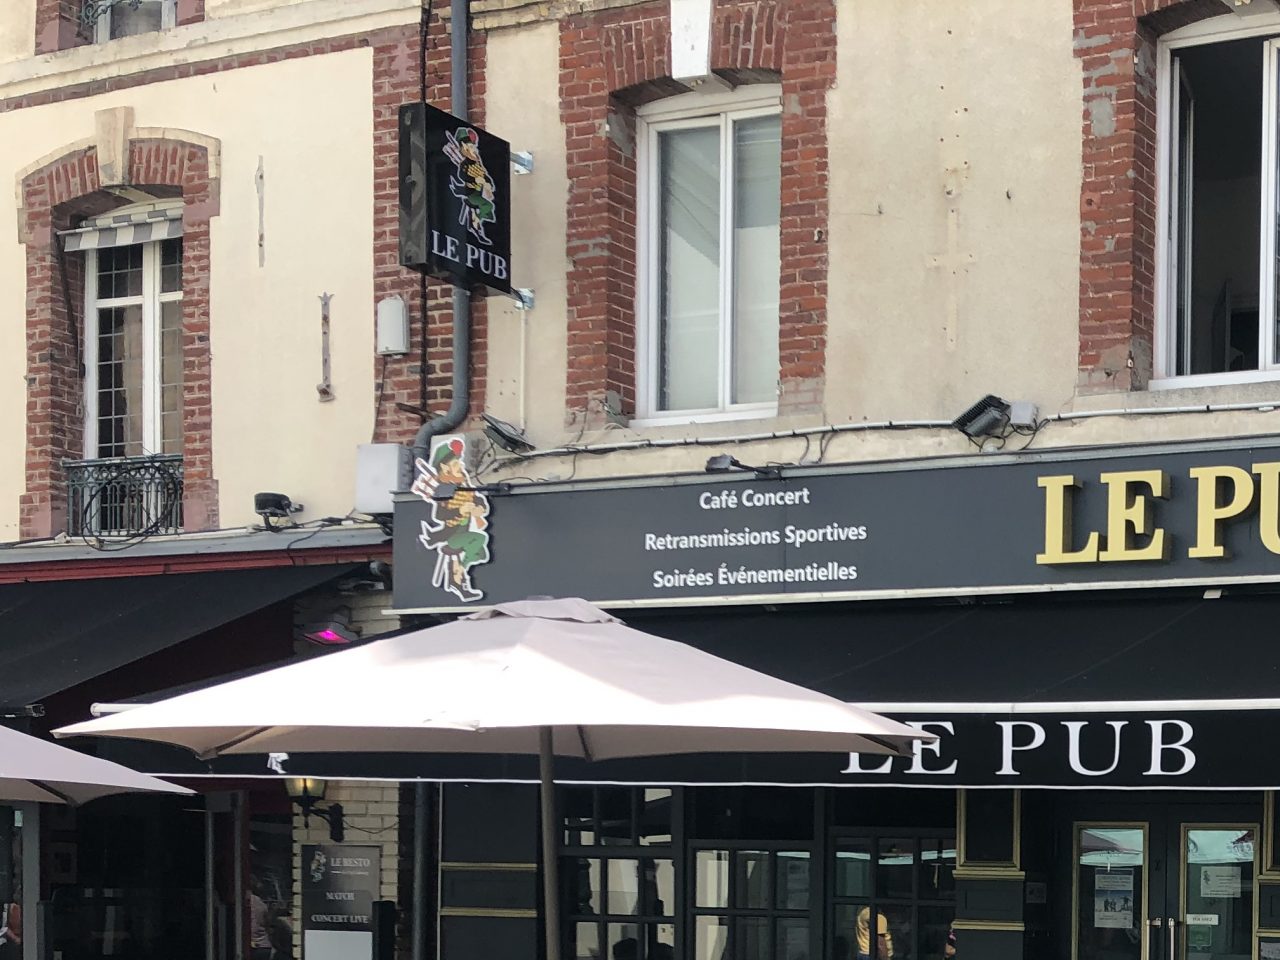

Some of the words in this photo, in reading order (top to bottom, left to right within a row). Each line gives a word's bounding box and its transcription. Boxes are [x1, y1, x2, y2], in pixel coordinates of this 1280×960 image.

[431, 229, 460, 263] LE
[465, 242, 507, 280] PUB
[700, 489, 738, 509] Café
[741, 487, 810, 507] Concert
[1036, 469, 1168, 565] LE
[644, 527, 781, 550] Retransmissions
[784, 522, 867, 548] Sportives
[653, 568, 714, 588] Soirées
[717, 561, 858, 585] Événementielles
[995, 719, 1196, 776] PUB
